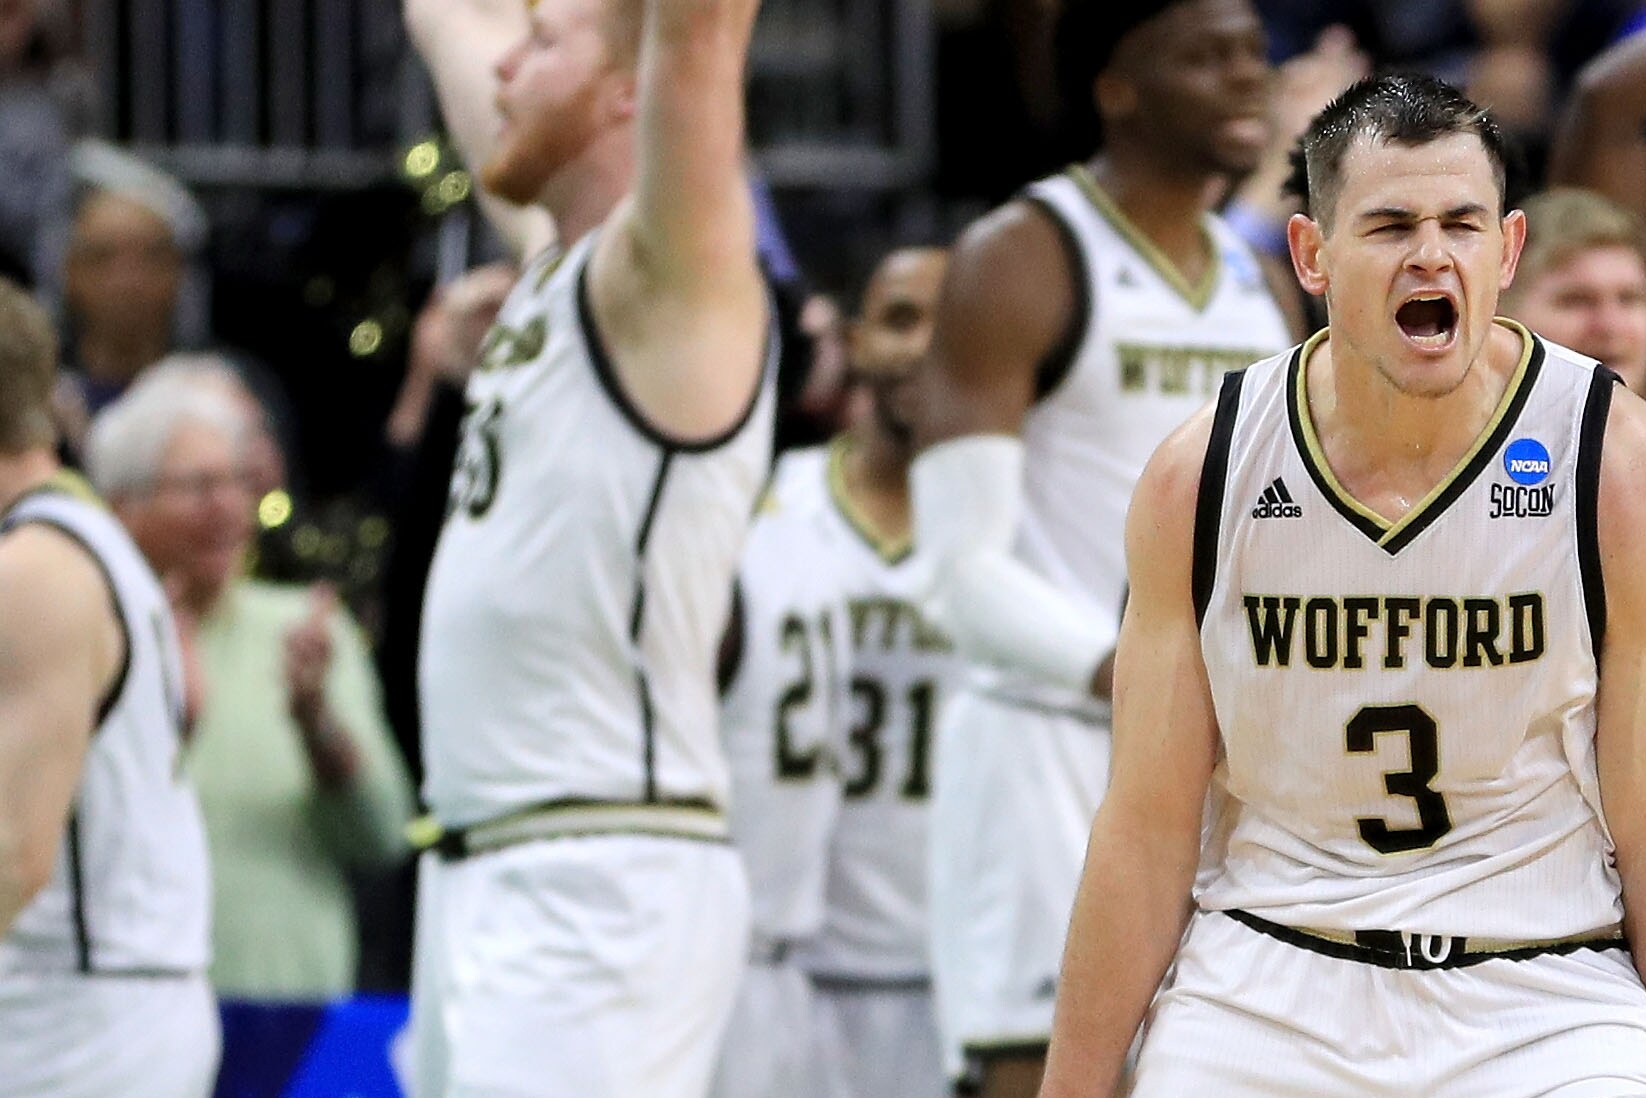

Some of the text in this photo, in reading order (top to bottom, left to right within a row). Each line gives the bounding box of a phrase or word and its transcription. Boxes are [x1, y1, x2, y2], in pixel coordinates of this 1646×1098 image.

[1510, 459, 1549, 473] NCAA
[1252, 502, 1302, 518] adidas
[1489, 482, 1555, 518] SOCON
[1242, 591, 1546, 669] WOFFORD
[845, 670, 936, 802] 31
[1343, 702, 1453, 856] 3
